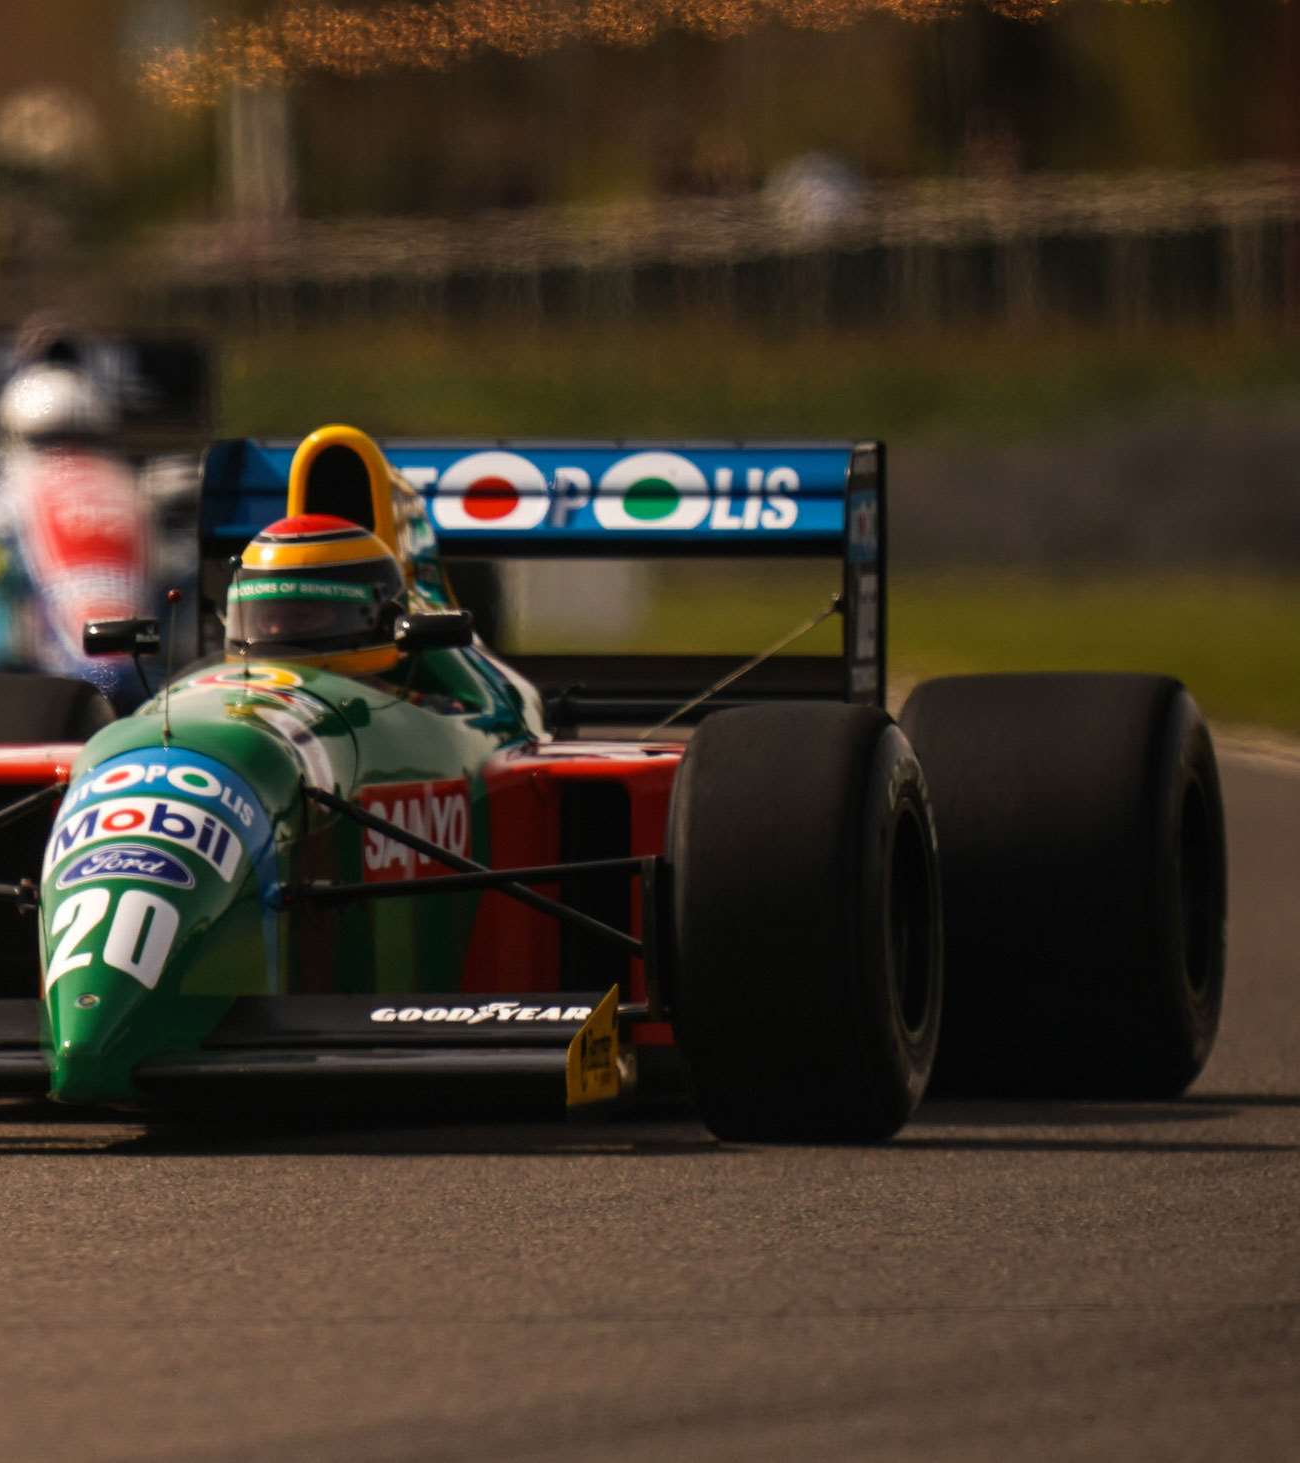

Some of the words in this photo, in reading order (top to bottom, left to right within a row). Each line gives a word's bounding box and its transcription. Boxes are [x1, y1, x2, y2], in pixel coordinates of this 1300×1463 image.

[279, 582, 297, 593] OF
[52, 803, 231, 866] Mobil
[364, 794, 466, 871] SANYO
[81, 848, 166, 875] Ford
[46, 887, 180, 991] 20
[371, 1003, 592, 1024] GOODYEAR
